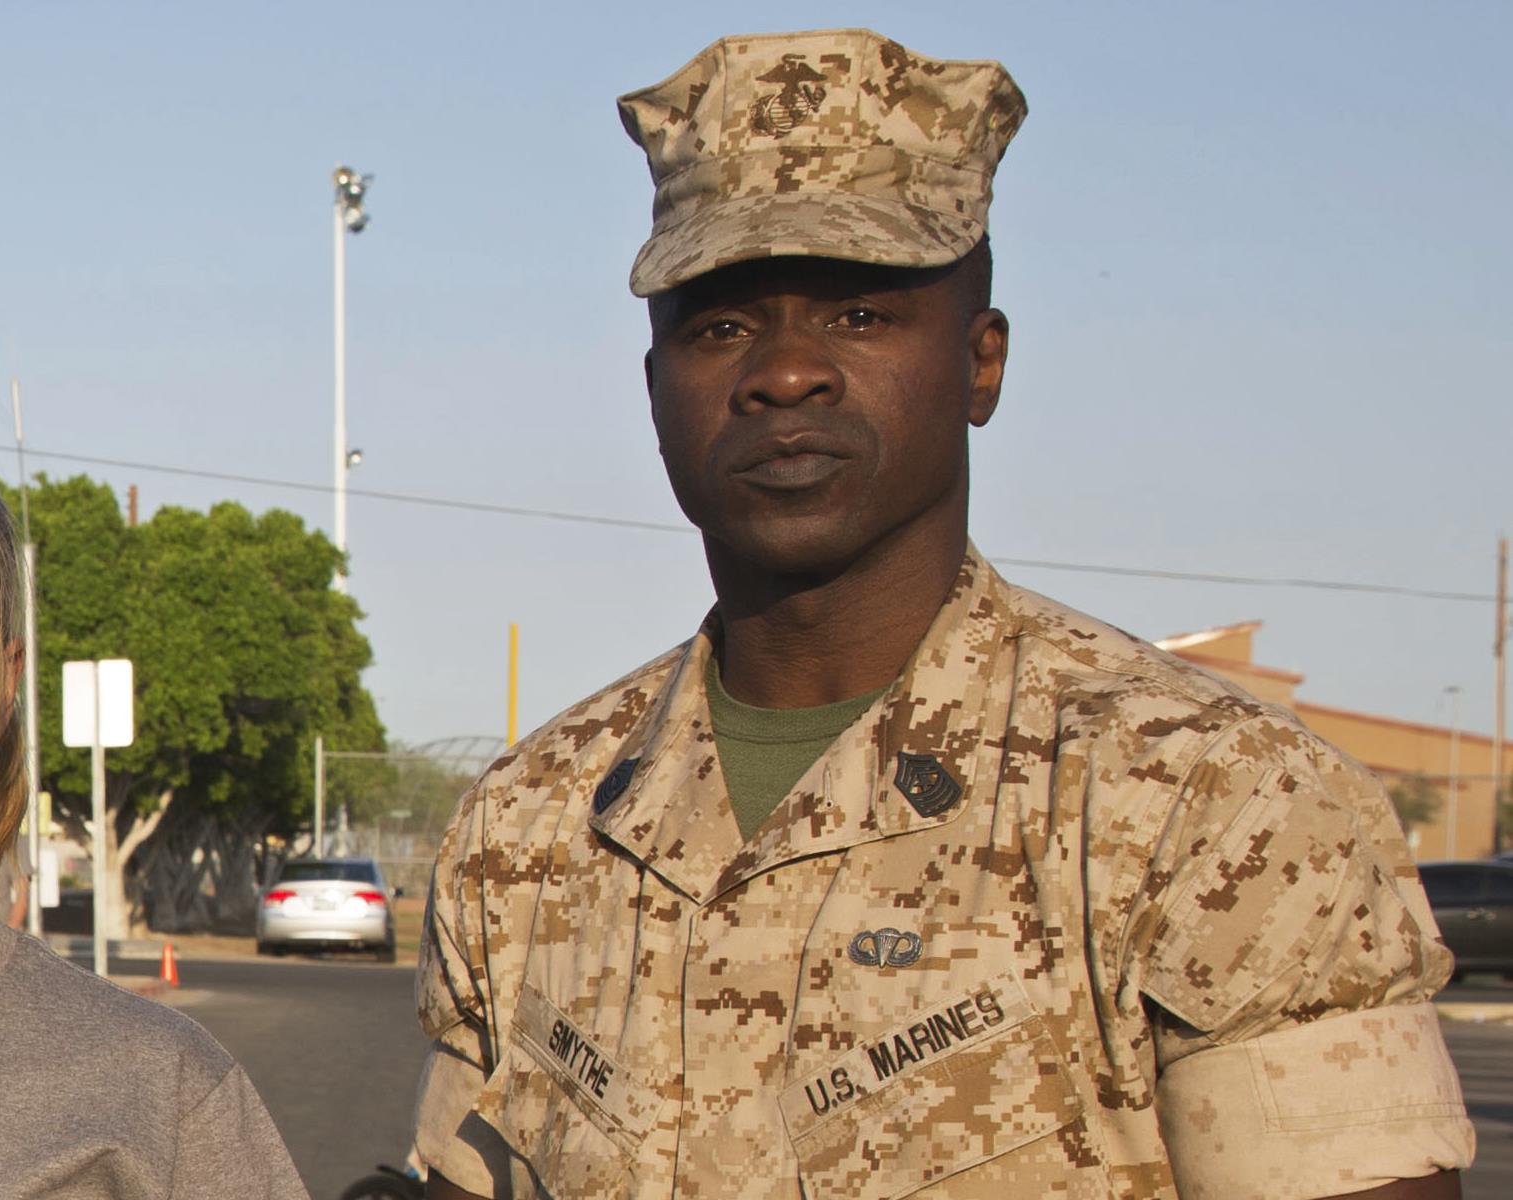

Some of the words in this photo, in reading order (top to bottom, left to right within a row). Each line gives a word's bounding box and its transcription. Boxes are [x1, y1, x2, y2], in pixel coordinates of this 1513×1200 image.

[549, 1019, 614, 1099] SMYTHE
[804, 1067, 868, 1118] U.S.
[867, 991, 1006, 1082] MARINES
